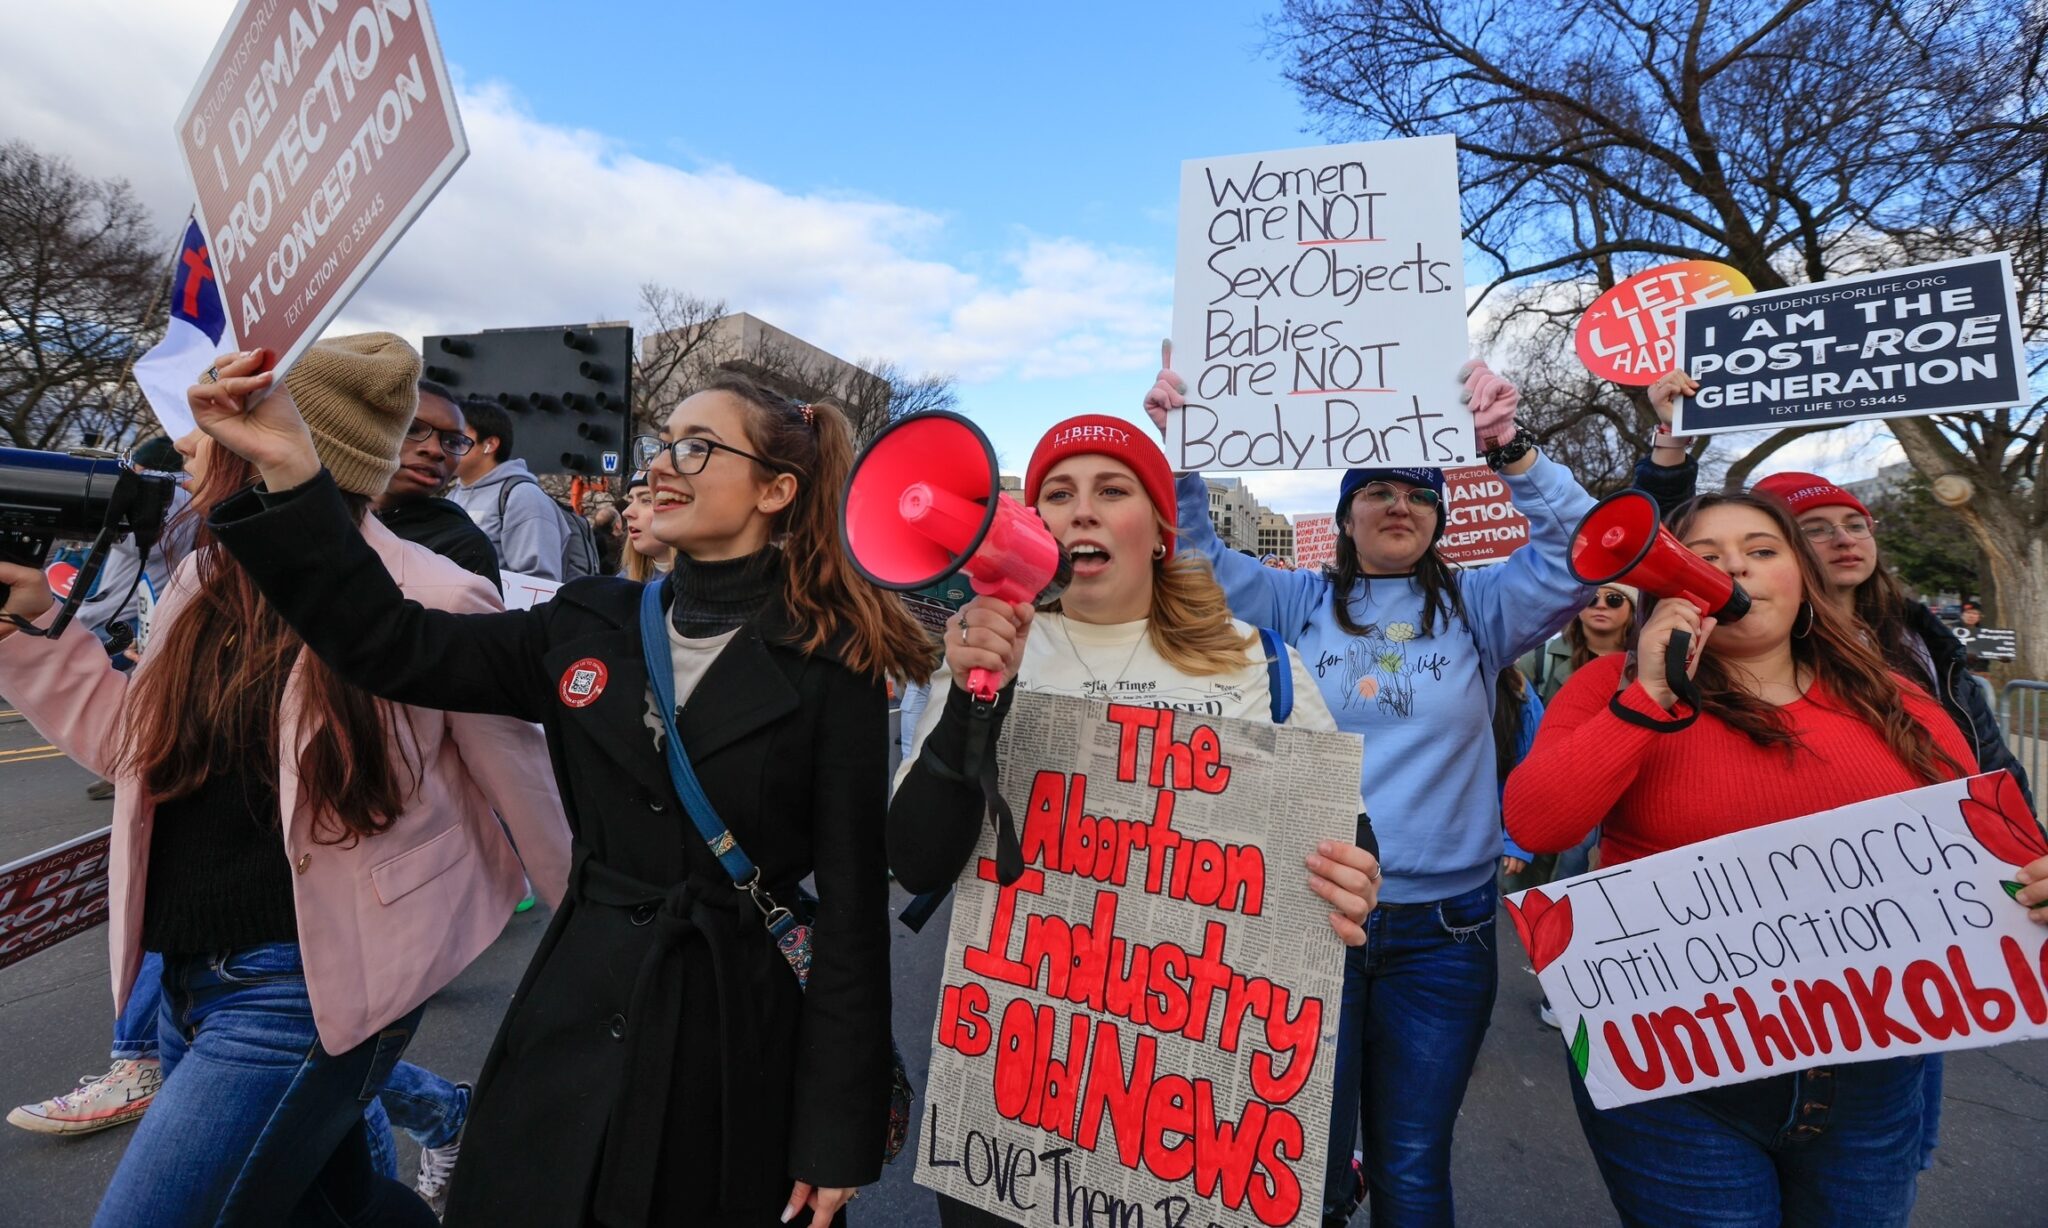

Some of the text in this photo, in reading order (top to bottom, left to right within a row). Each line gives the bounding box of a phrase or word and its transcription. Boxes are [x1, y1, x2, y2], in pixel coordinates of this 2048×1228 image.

[213, 144, 229, 192] I
[214, 0, 412, 284] PROTECTION
[241, 53, 427, 337] AT CONCEPTION
[1205, 160, 1367, 207] Women
[1208, 193, 1387, 246] are NOT
[283, 193, 385, 329] TEXT ACTION TO 53445
[1207, 242, 1452, 306] Sex Objects.
[1611, 271, 1689, 319] LET
[1704, 286, 1976, 347] I AM THE
[1752, 275, 1948, 315] STUDENTSFORLIFE.ORG
[1205, 305, 1344, 362] Babies
[1612, 335, 1677, 375] HAP
[1691, 313, 2001, 381] POST-ROE
[1197, 342, 1400, 400] are NOT
[1695, 353, 1998, 410] GENERATION
[1180, 395, 1465, 470] Body Parts.
[1768, 394, 1907, 416] TEXT LIFE TO 53445
[603, 453, 617, 471] W
[1055, 425, 1131, 443] LIBERTY
[1392, 468, 1420, 480] AMERICA
[1296, 517, 1332, 528] BEFORE THE
[1115, 680, 1156, 692] Times
[1315, 650, 1450, 681] for life
[1107, 702, 1232, 795] The
[1021, 770, 1266, 917] Abortion
[1566, 814, 1978, 945] I will march
[33, 921, 88, 948] ACTION
[1562, 879, 1994, 1010] until abortion is
[963, 858, 1324, 1105] Industry
[993, 998, 1091, 1142] Old
